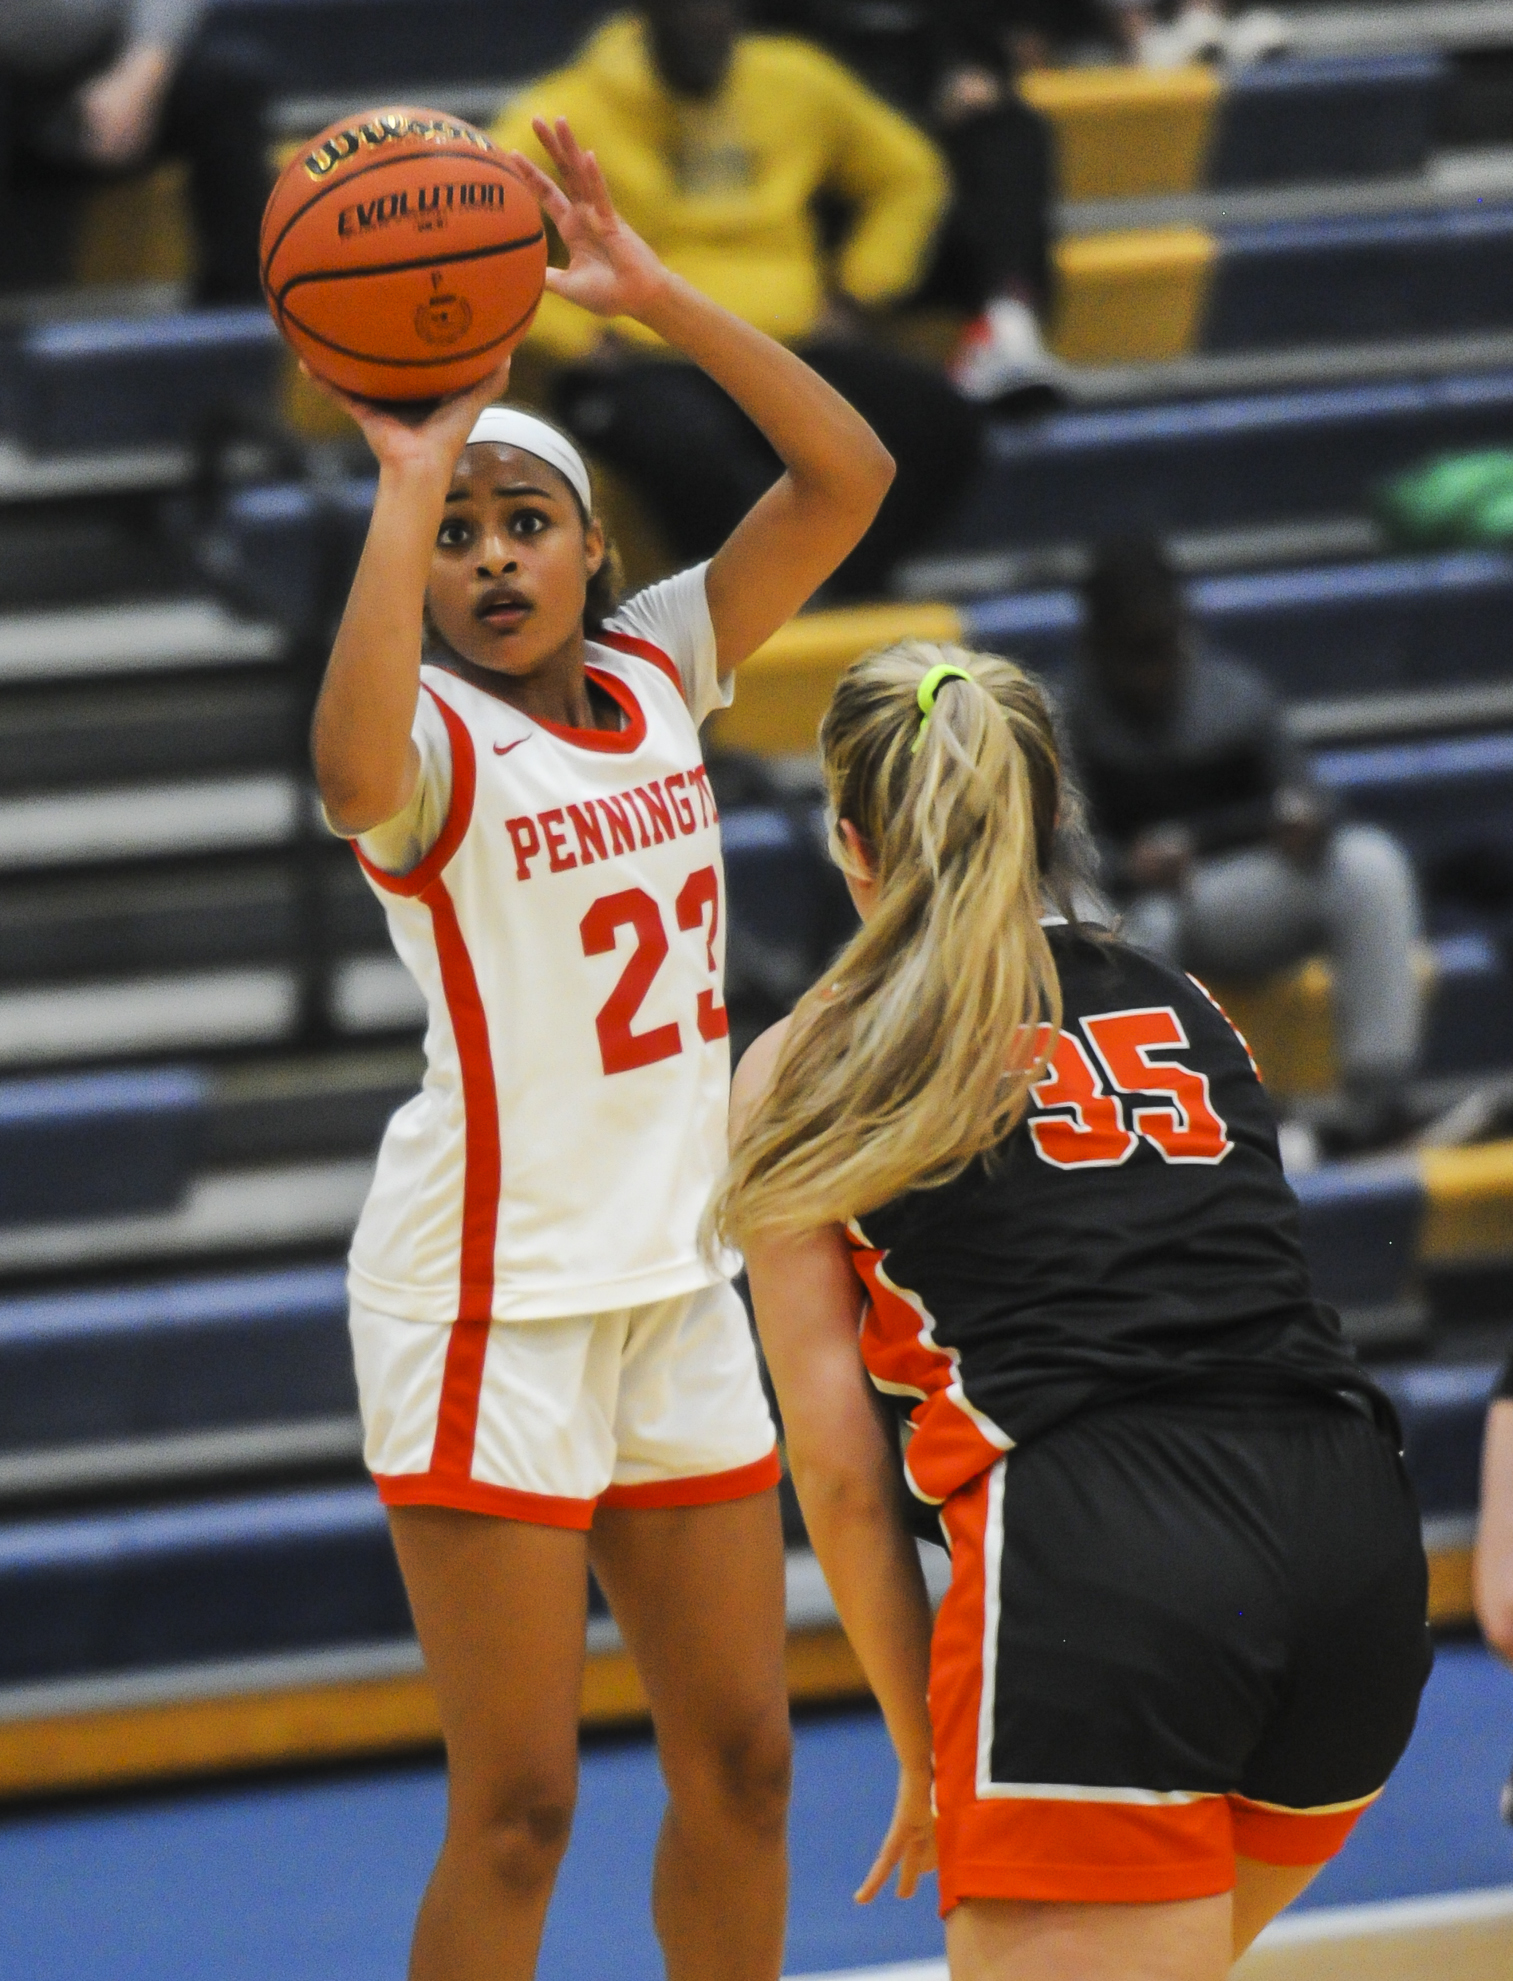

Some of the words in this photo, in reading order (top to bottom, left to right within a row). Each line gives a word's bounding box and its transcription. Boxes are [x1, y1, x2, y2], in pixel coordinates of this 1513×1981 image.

[337, 182, 504, 237] EVOLUTION
[579, 865, 728, 1076] 23
[1004, 1005, 1234, 1170] 35
